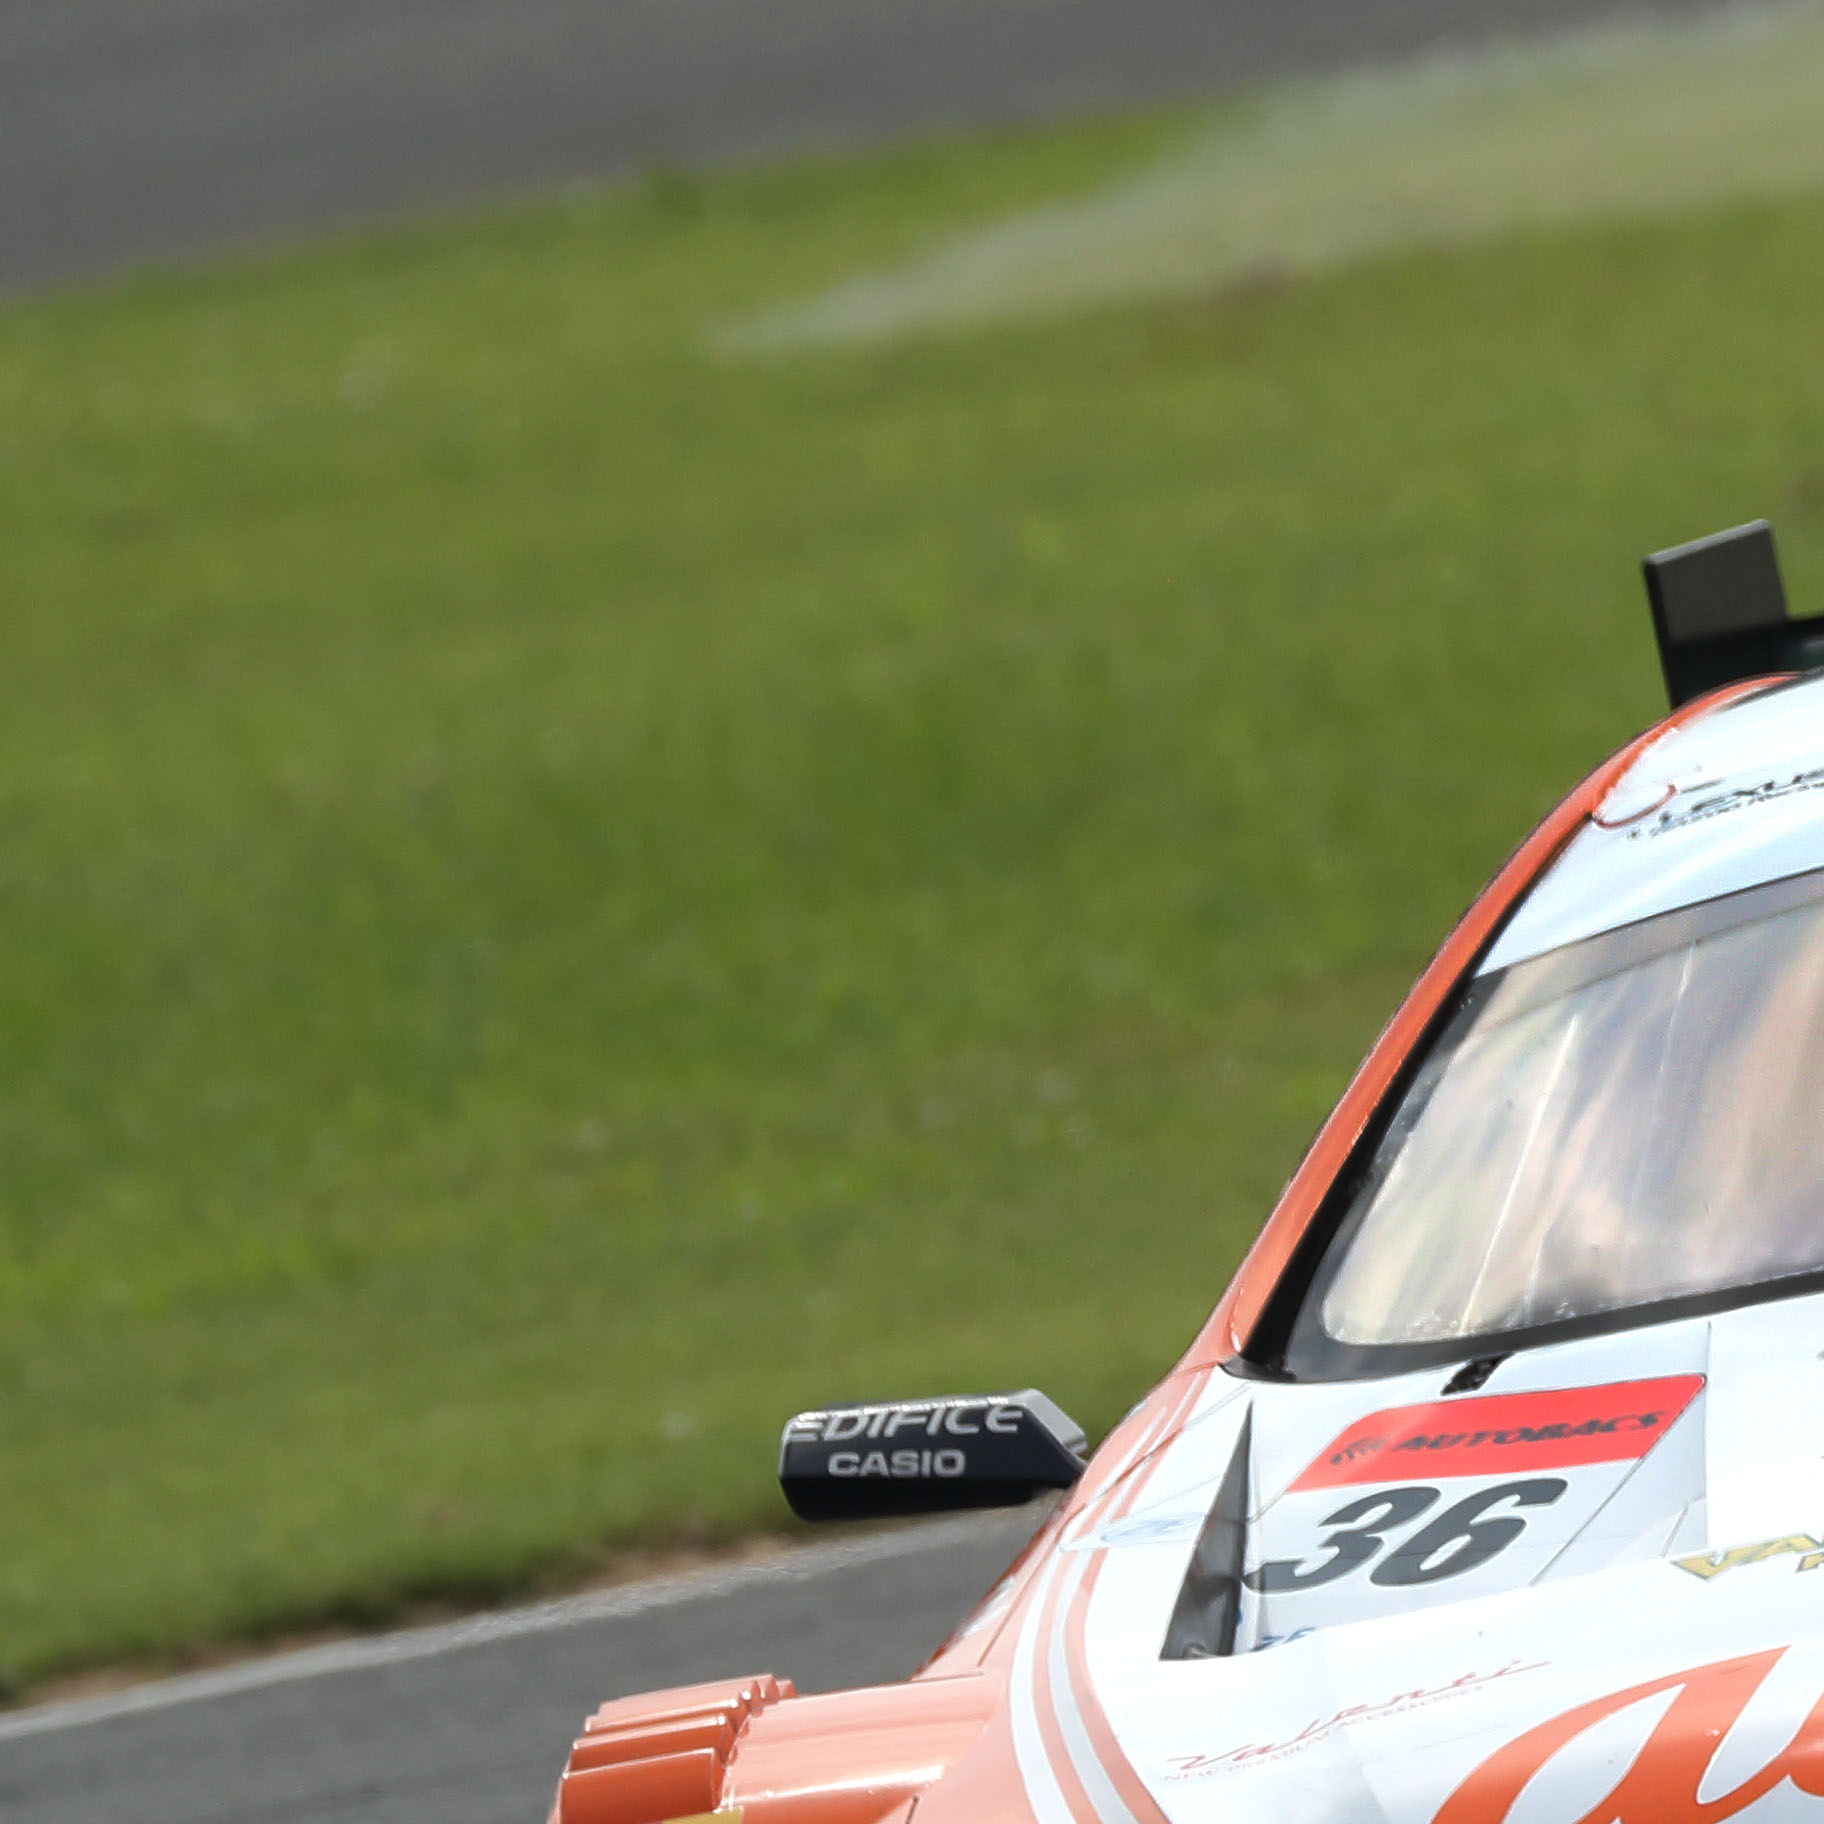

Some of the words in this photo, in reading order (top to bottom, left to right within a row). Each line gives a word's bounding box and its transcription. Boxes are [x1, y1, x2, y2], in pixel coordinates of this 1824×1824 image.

[786, 1397, 1024, 1443] EDIFICE
[1391, 1409, 1668, 1454] AUTOBACS
[826, 1449, 968, 1478] CASIO
[1243, 1477, 1569, 1594] 36
